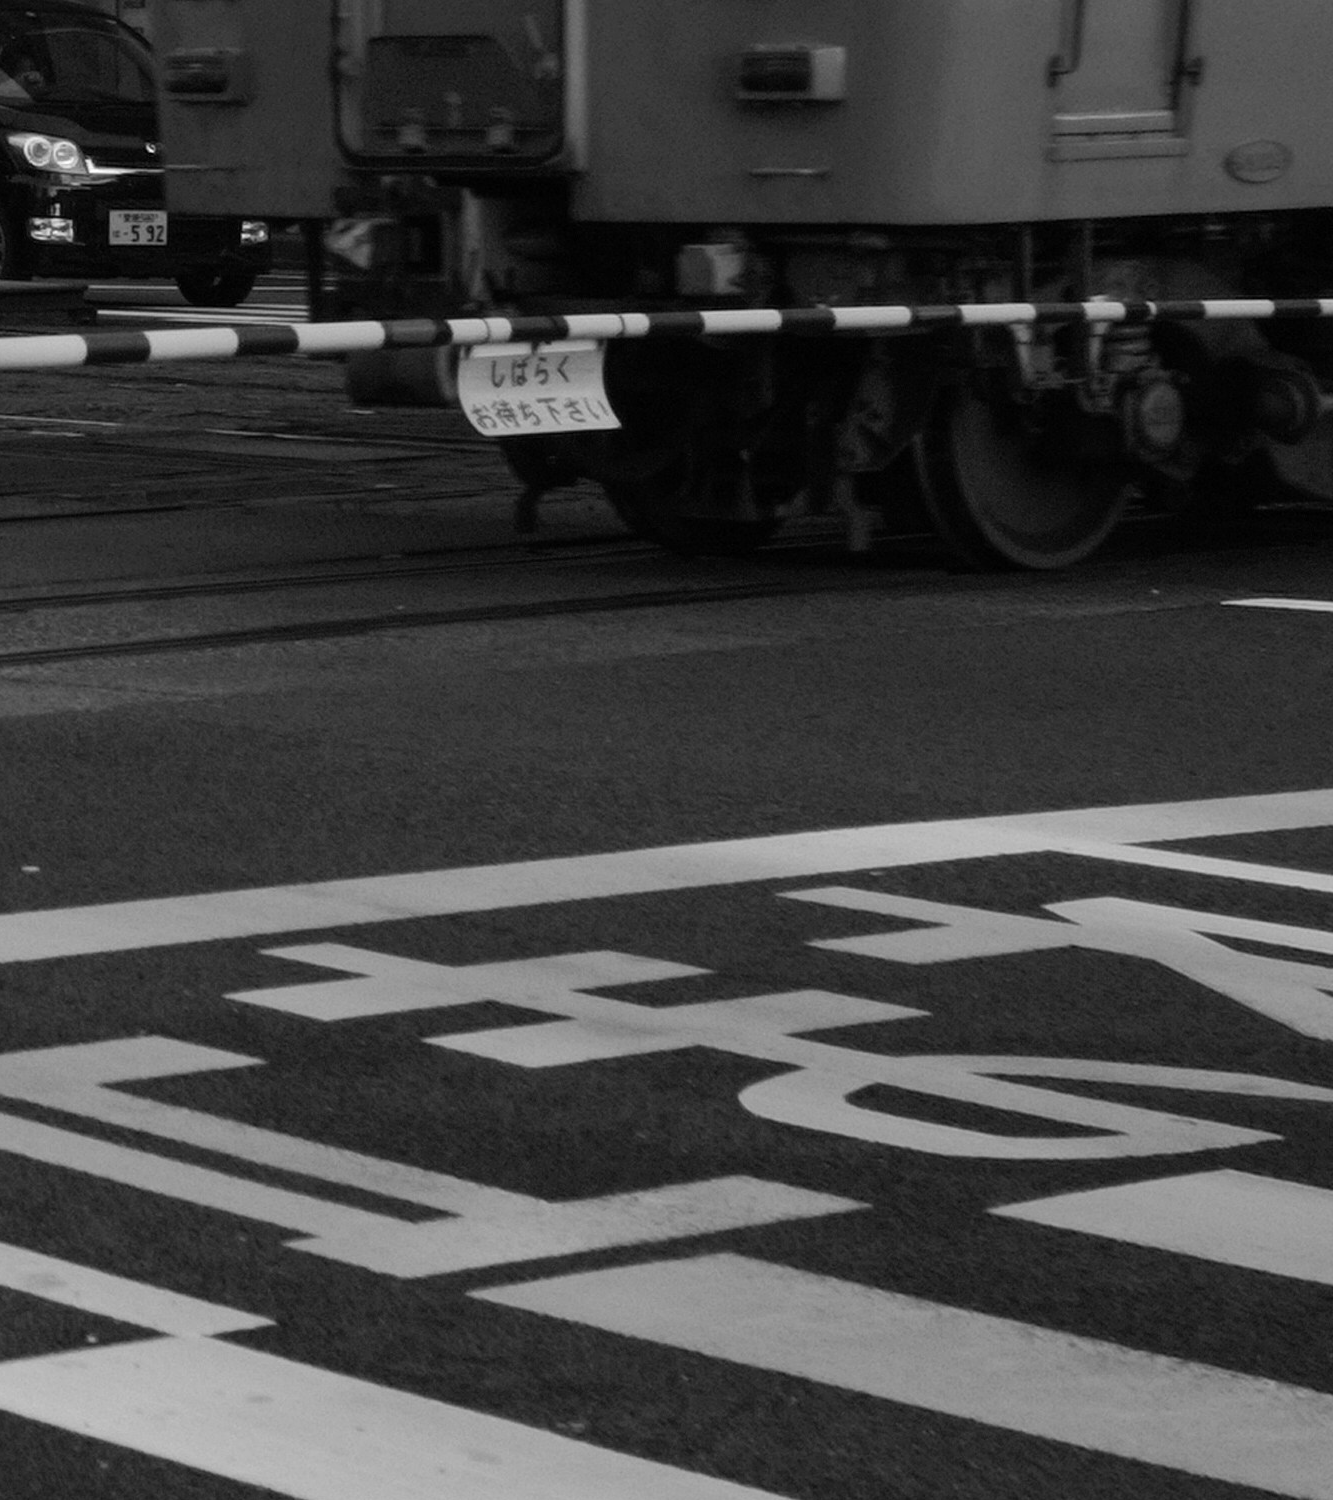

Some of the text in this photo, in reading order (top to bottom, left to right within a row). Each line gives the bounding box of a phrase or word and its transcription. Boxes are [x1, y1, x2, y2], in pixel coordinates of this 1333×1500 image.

[491, 354, 571, 388] しばらく
[471, 397, 610, 431] お待ち下さい
